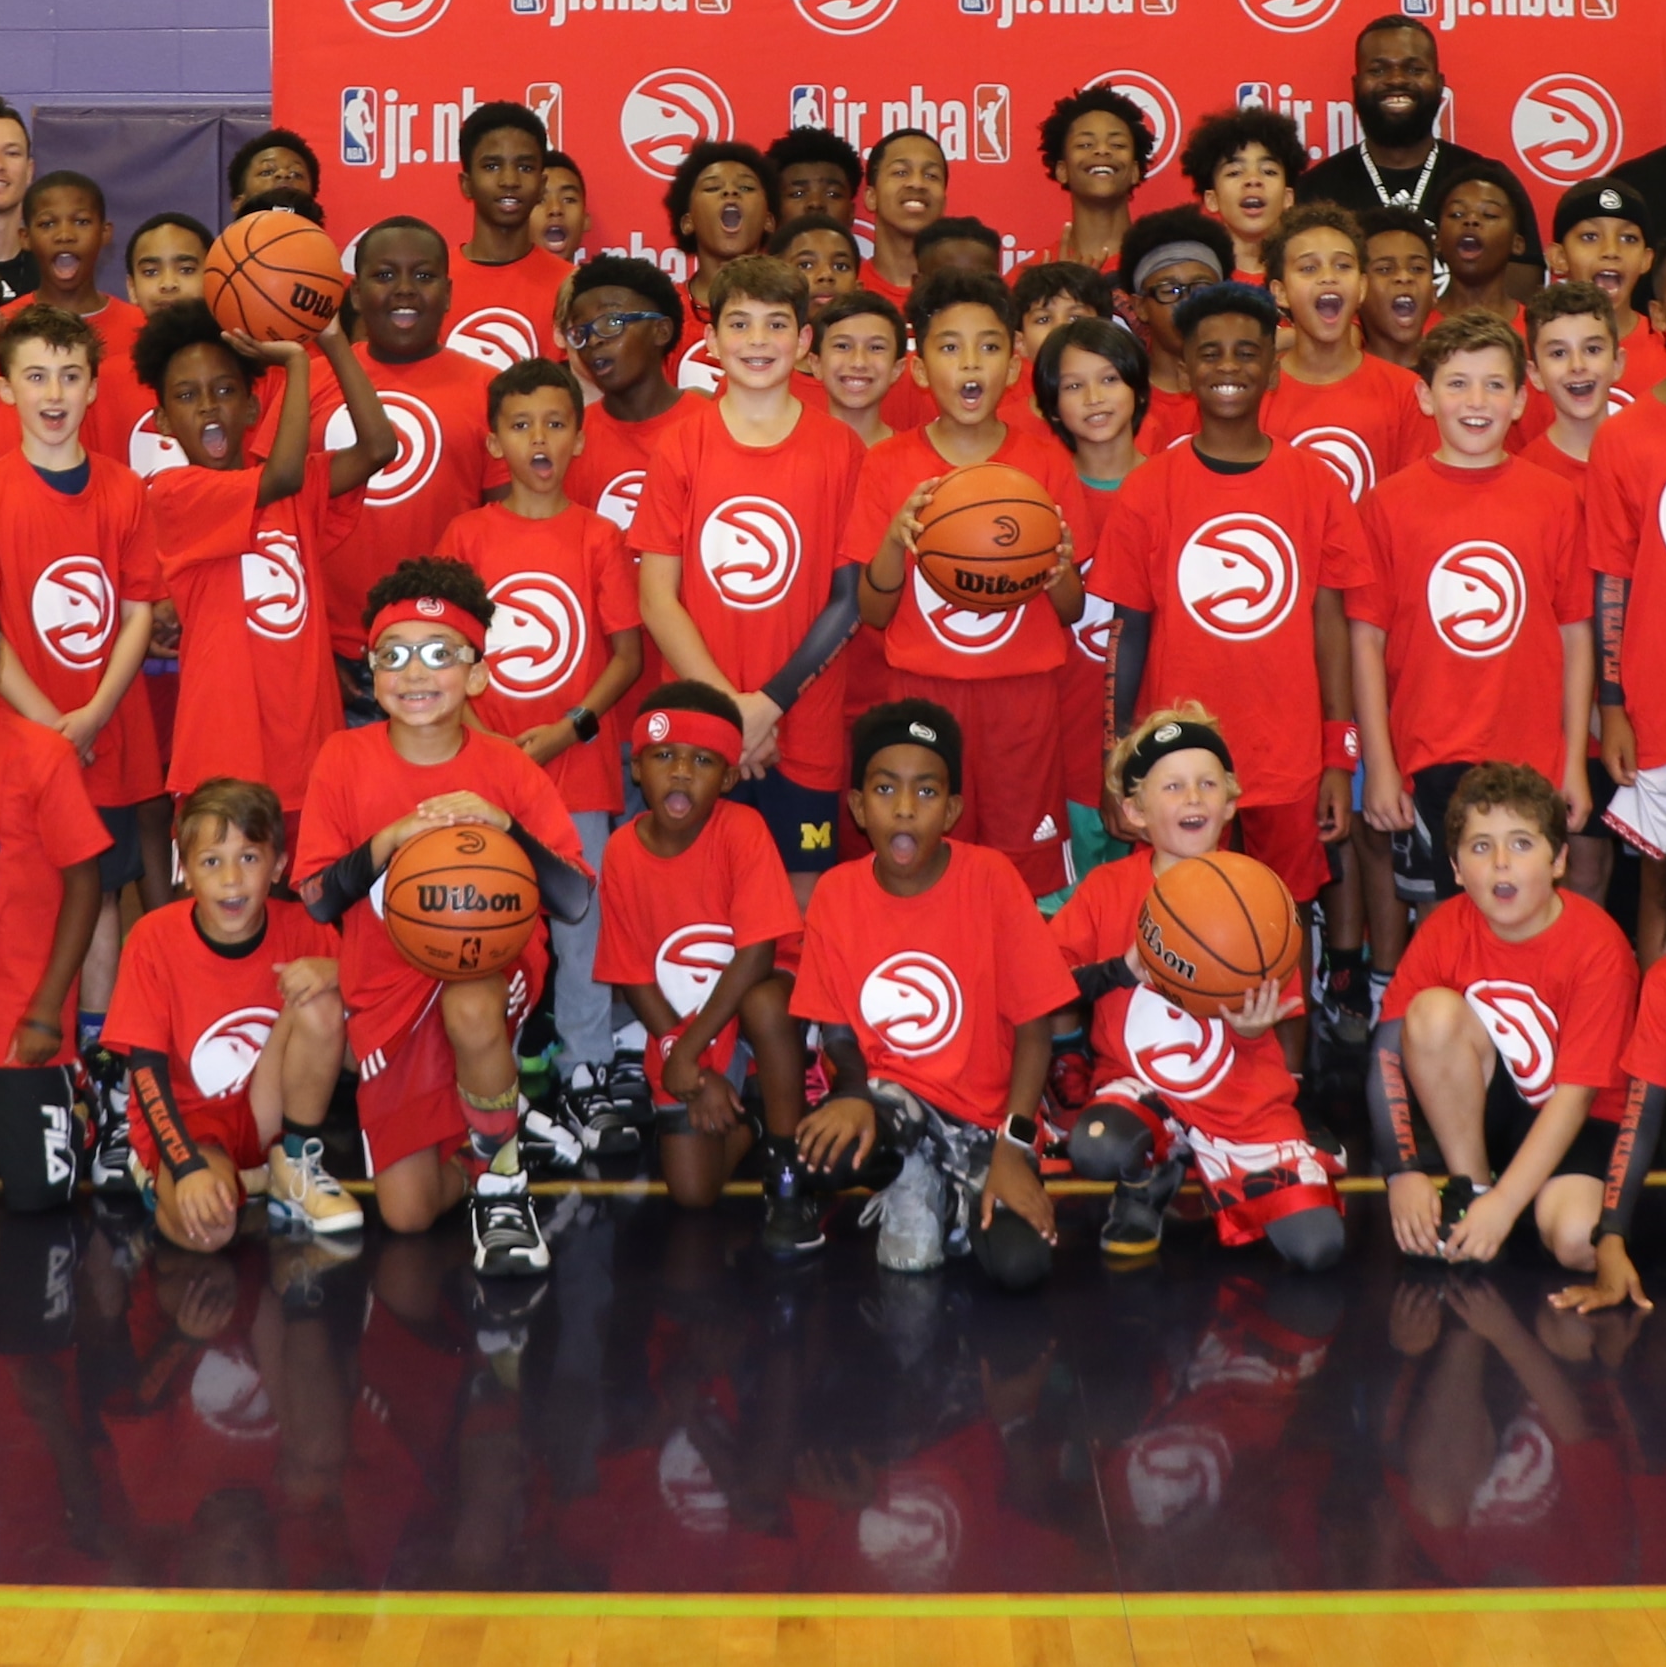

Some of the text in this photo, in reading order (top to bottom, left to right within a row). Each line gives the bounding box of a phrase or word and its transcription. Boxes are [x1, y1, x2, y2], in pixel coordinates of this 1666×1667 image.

[954, 568, 1048, 595] Wilson
[801, 822, 831, 849] M
[417, 884, 521, 912] Wilson
[41, 1106, 70, 1184] FILA
